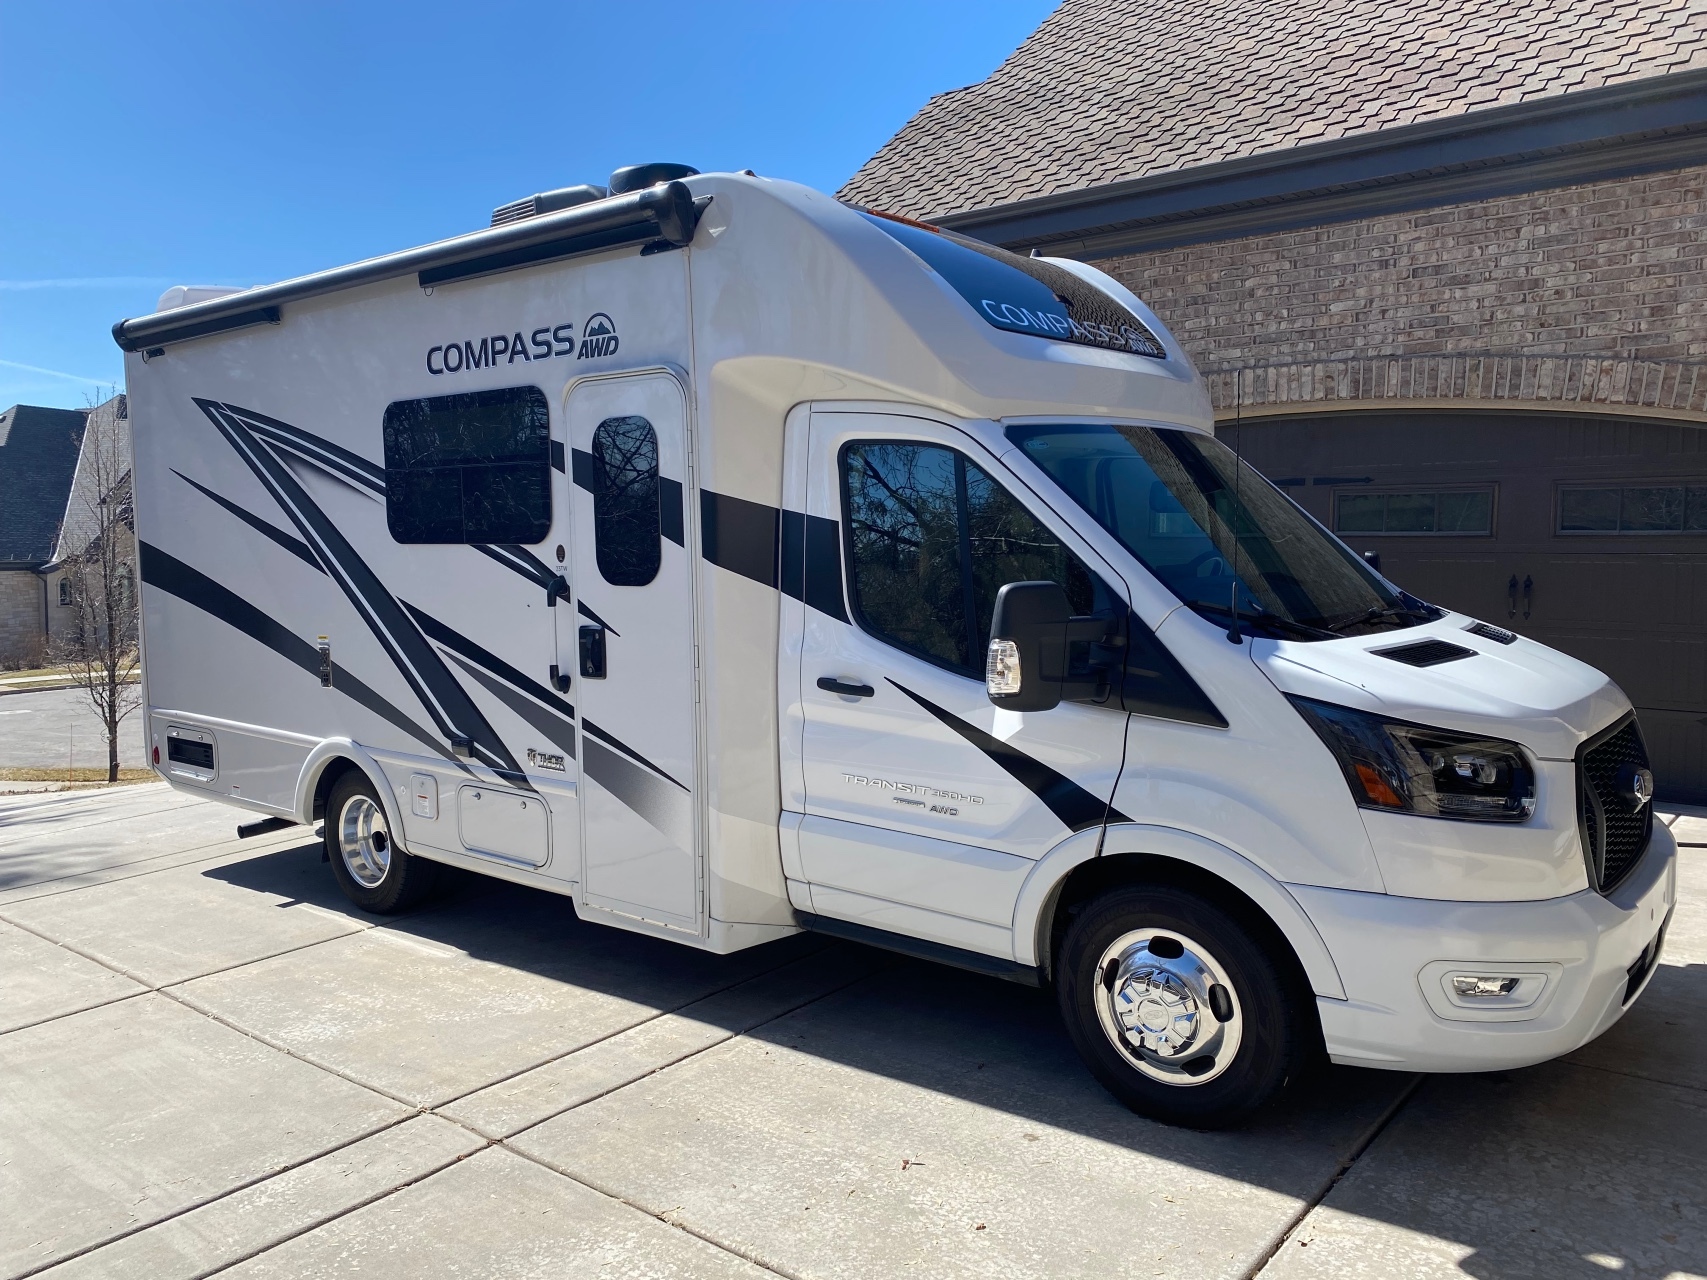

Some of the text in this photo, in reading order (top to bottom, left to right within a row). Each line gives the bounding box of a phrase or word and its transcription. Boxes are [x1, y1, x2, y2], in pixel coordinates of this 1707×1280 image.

[982, 300, 1125, 344] COMPASS
[427, 323, 619, 375] COMPASS AWD
[842, 773, 931, 796] TRANSIT
[930, 804, 959, 816] AWD
